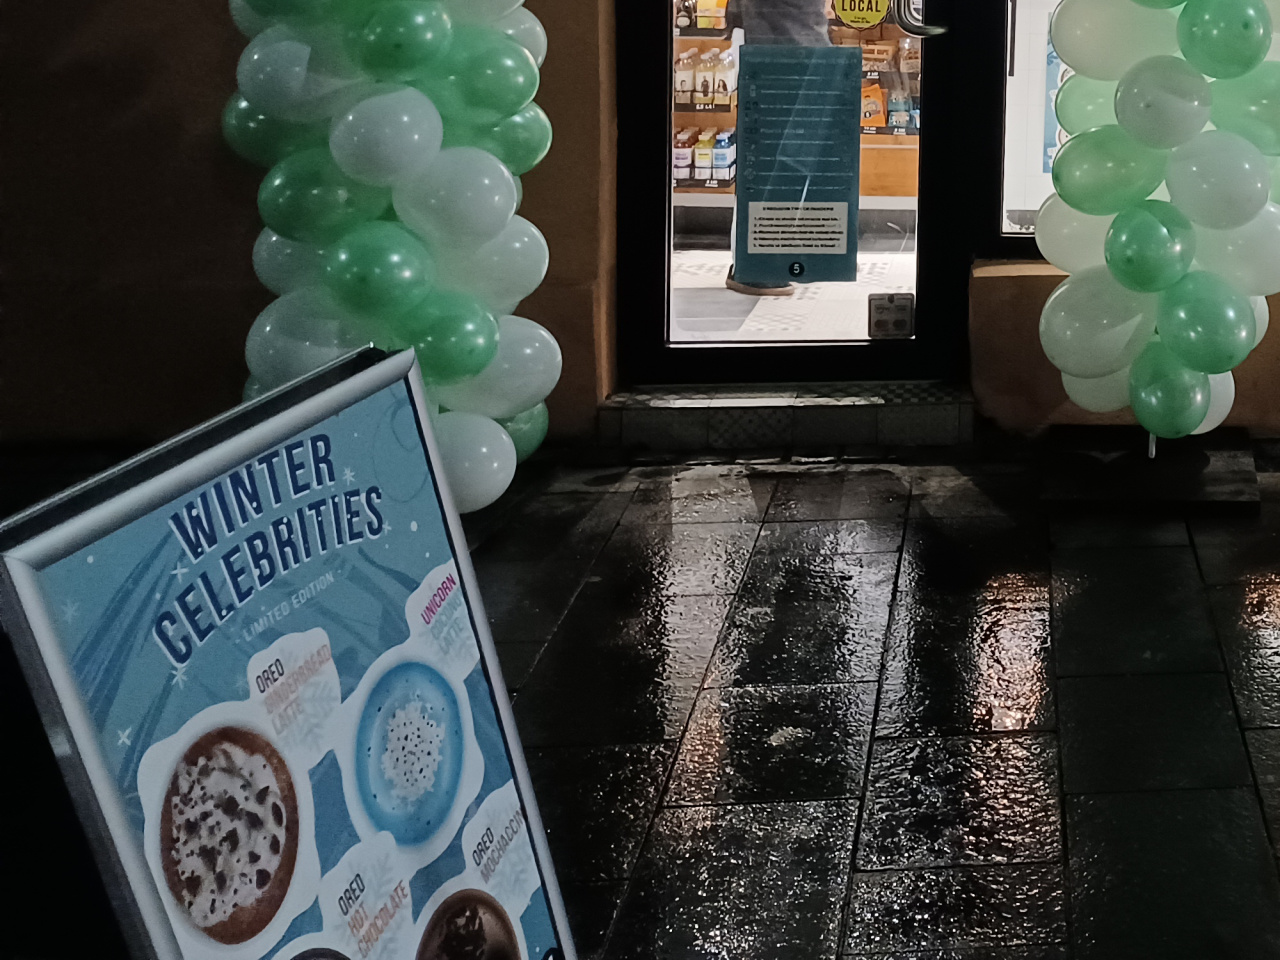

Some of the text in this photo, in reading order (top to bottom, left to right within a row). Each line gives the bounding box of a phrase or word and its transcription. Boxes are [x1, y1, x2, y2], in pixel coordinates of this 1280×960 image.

[841, 0, 881, 12] LOCAL
[793, 263, 800, 274] 5
[168, 434, 336, 564] WINTER
[152, 486, 384, 667] CELEBRITIES
[242, 571, 334, 642] LIMITED EDITION
[420, 573, 456, 625] UNICORN
[255, 658, 285, 693] OREO
[472, 827, 495, 866] OREO
[338, 873, 366, 916] OREO
[347, 901, 369, 937] HOT
[357, 879, 408, 959] CHOCOLATE
